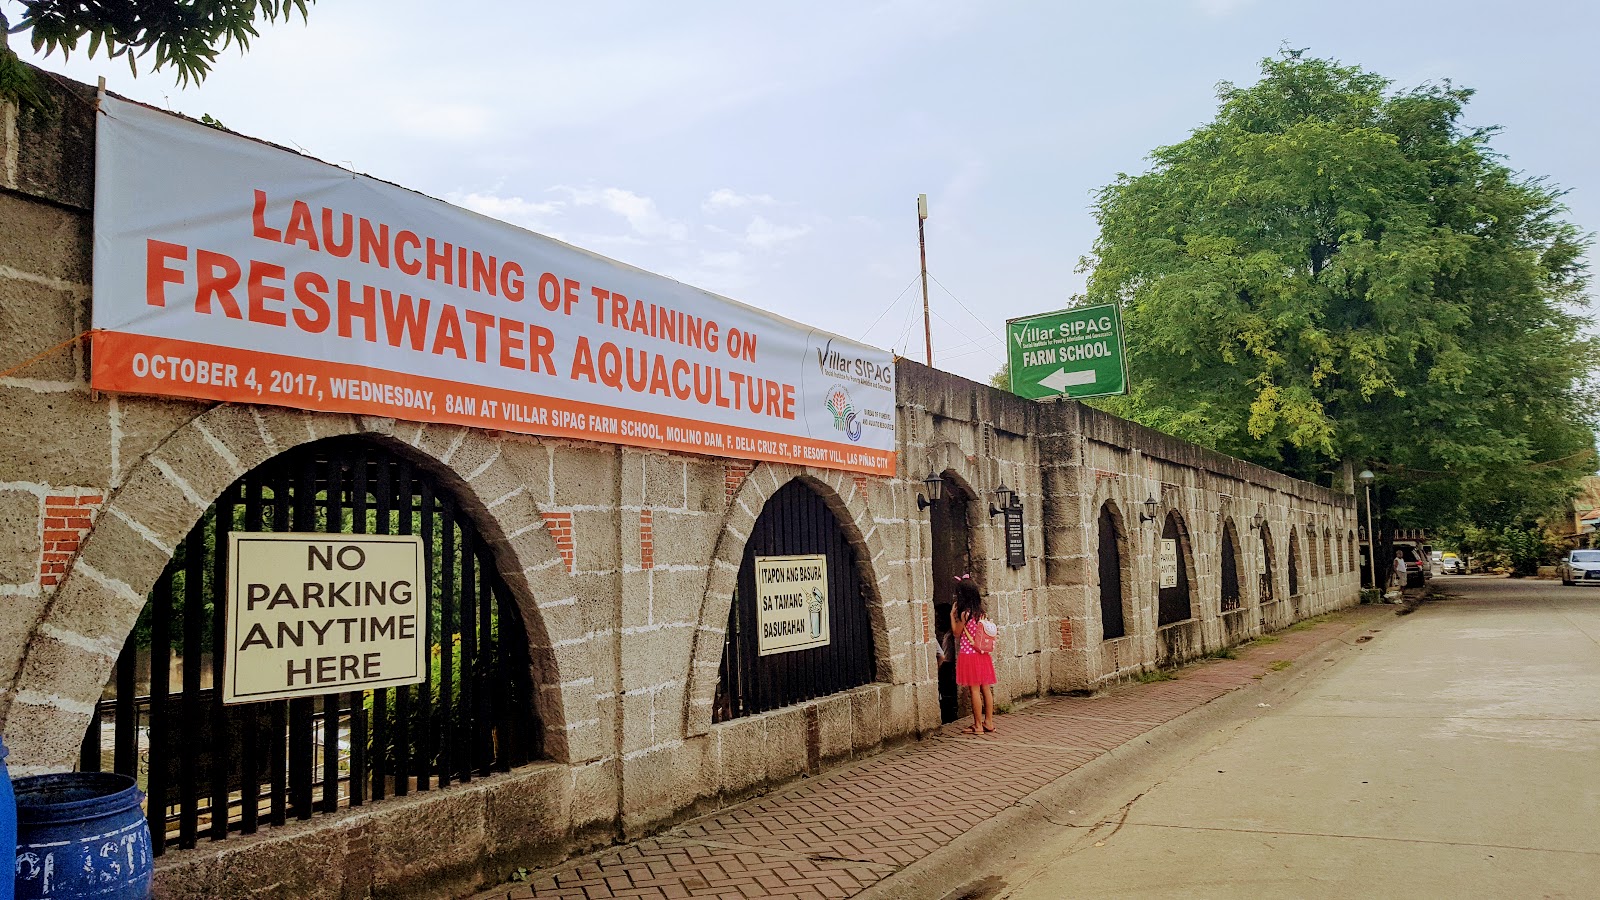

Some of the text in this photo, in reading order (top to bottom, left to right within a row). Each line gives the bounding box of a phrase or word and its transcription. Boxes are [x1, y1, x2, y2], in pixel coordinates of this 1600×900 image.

[252, 188, 757, 364] LAUNCHING OF TRAINING ON
[146, 238, 796, 421] FRESHWATER AQUACULTURE
[1013, 316, 1112, 349] Villar SIPAG
[816, 337, 852, 375] Villar
[854, 358, 891, 385] SIPAG
[1022, 341, 1111, 368] FARM SCHOOL
[132, 352, 238, 388] OCTOBER
[244, 367, 263, 396] 4,
[269, 370, 323, 402] 2017,
[330, 377, 436, 415] WEDNESDAY,
[445, 394, 476, 416] 8AM
[480, 400, 498, 419] AT
[501, 402, 549, 426] VILLAR
[551, 409, 586, 431] SIPAG
[589, 415, 618, 435] FARM
[620, 419, 664, 443] SCHOOL,
[666, 426, 702, 445] MOLINO
[704, 431, 725, 451] DAM,
[727, 435, 734, 449] F.
[735, 436, 755, 453] DELA
[757, 439, 777, 455] CRUZ
[792, 444, 801, 458] BF
[803, 446, 828, 462] RESORT
[847, 452, 858, 465] LAS
[876, 457, 888, 469] CITY
[307, 545, 366, 571] NO
[761, 565, 822, 584] ITAPON ANG BASURA
[247, 580, 412, 611] PARKING
[763, 593, 803, 611] SA TAMANG
[239, 614, 415, 651] ANYTIME
[764, 619, 805, 638] BASURAHAN
[286, 652, 381, 686] HERE
